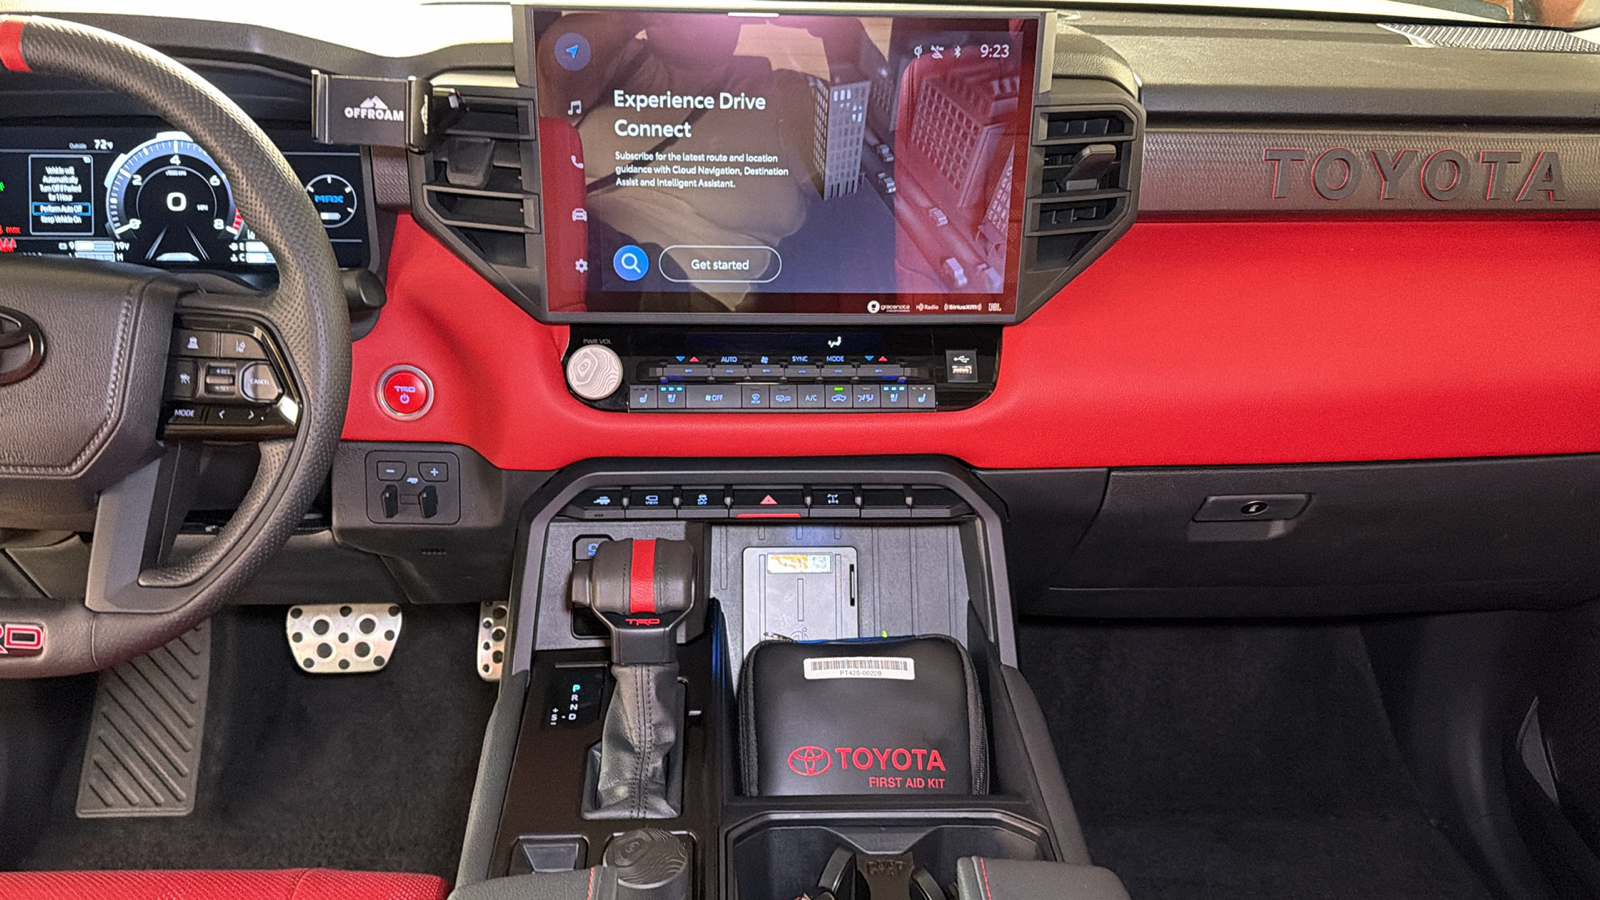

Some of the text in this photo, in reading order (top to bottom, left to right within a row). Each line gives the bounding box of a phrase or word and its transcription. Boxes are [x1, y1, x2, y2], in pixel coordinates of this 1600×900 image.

[980, 44, 1010, 58] 9:23
[613, 90, 767, 111] Experience Drive
[344, 107, 404, 121] OFFROAM
[614, 119, 692, 138] Connect
[170, 155, 181, 166] 4
[615, 151, 778, 163] Subscribe for the latest route and location
[615, 165, 789, 177] guidance with Cloud Navigation, Destination
[1262, 147, 1566, 202] TOYOTA
[131, 175, 142, 186] 2
[209, 175, 221, 186] 6
[615, 177, 736, 189] Assist and Intelligent Assistant.
[166, 192, 187, 212] 0
[213, 219, 224, 230] 8
[691, 259, 750, 270] Get started
[880, 304, 911, 312] gracenote
[792, 355, 809, 363] SYNC
[826, 355, 845, 363] MODE
[805, 394, 818, 402] A/C
[174, 408, 195, 418] MODE
[625, 618, 660, 626] TRD
[572, 684, 581, 693] P
[571, 694, 579, 702] R
[569, 703, 578, 711] N
[568, 713, 577, 721] D
[834, 747, 947, 772] TOYOTA
[869, 777, 945, 789] FIRST AID KIT
